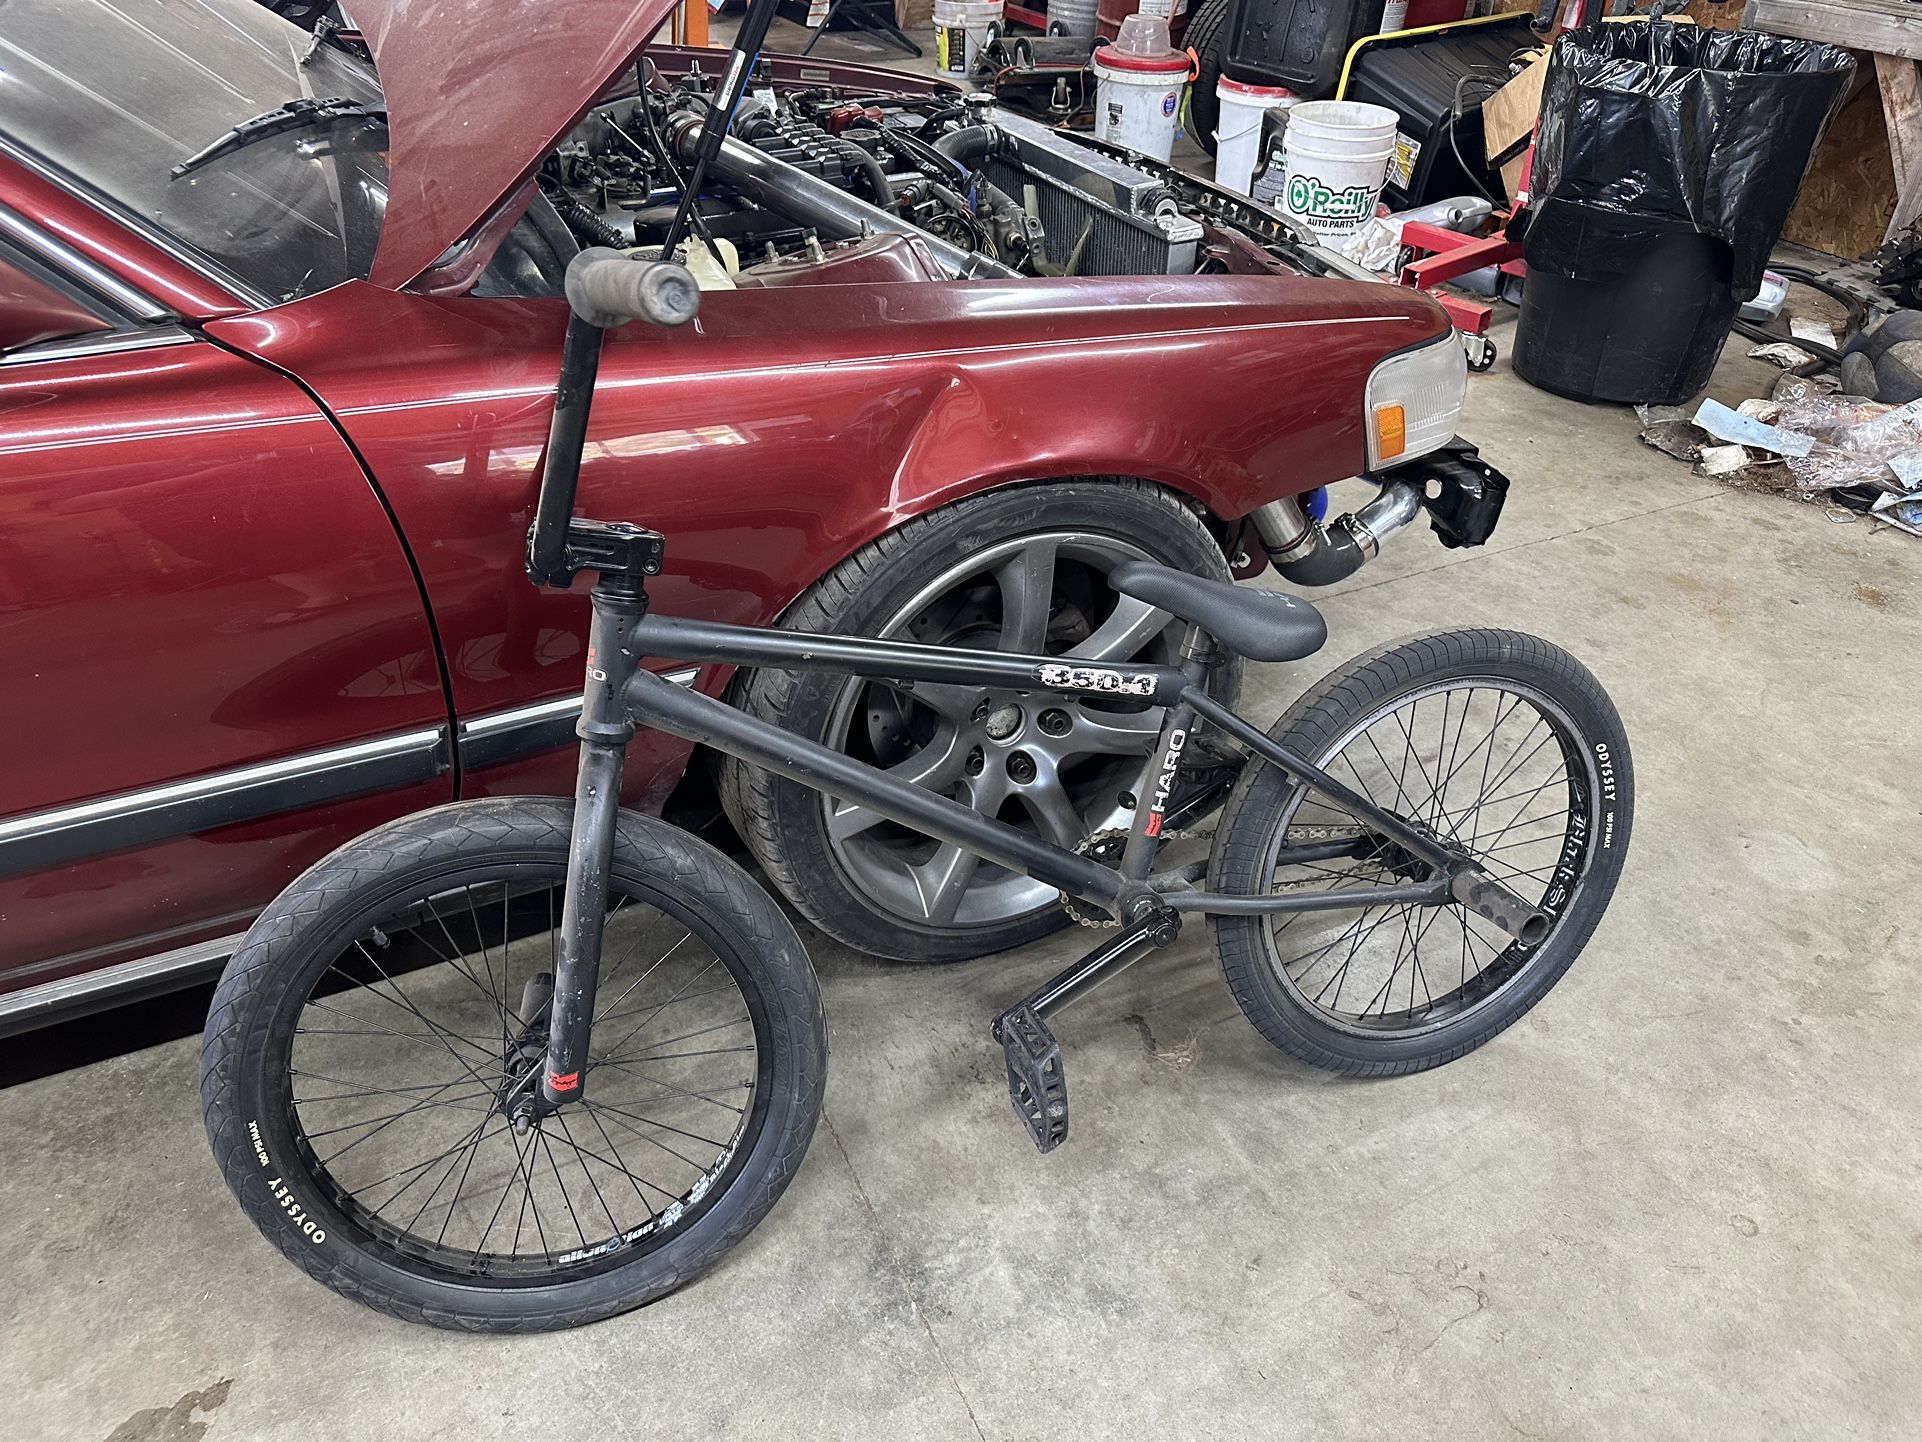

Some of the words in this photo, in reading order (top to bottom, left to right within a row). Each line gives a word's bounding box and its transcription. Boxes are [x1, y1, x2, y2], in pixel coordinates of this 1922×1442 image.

[1289, 177, 1375, 219] O'Reilly
[1307, 218, 1328, 228] AUTO
[1329, 219, 1355, 229] PARTS
[1151, 728, 1186, 812] HARO
[1595, 743, 1616, 801] ODYSSEY
[1605, 823, 1614, 833] PSI
[1603, 833, 1612, 849] MAX
[248, 1120, 261, 1140] MAX
[253, 1139, 265, 1154] PSI
[258, 1151, 270, 1167] 100
[267, 1177, 327, 1244] ODYSSEY
